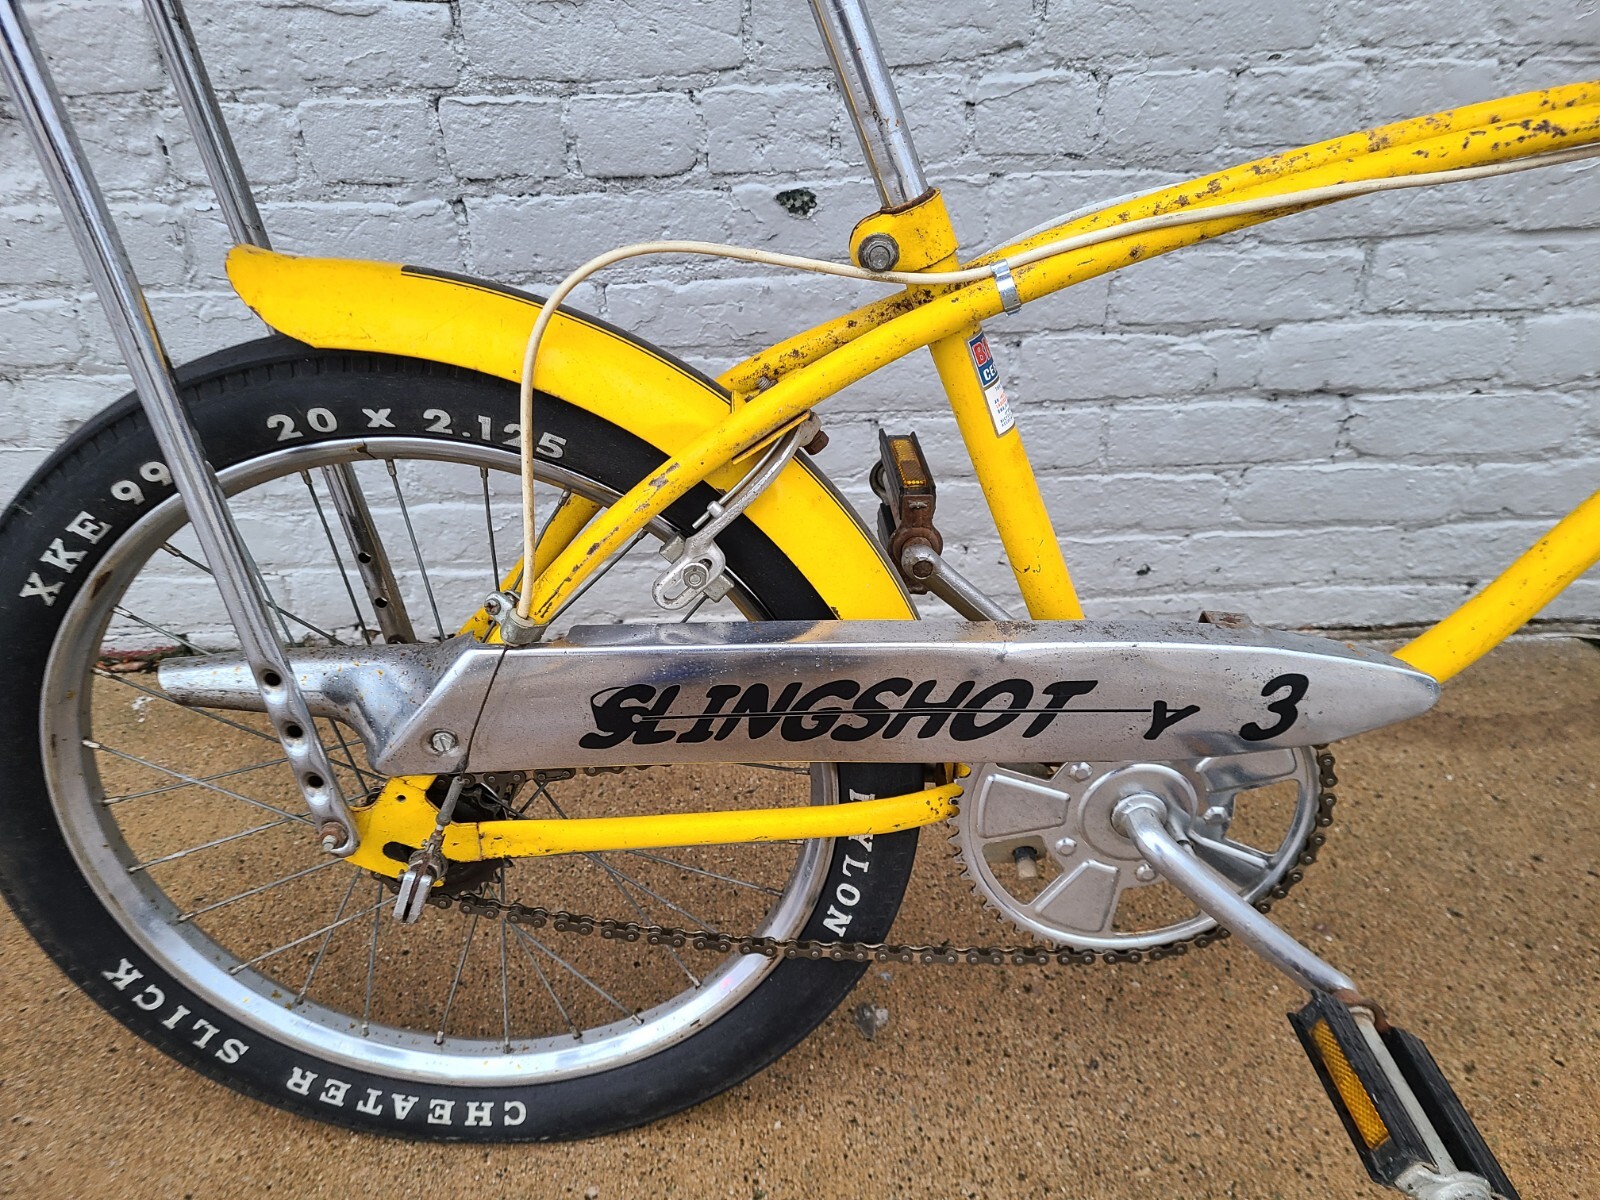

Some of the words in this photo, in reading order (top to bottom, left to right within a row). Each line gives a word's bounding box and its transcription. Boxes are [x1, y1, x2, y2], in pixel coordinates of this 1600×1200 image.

[266, 407, 338, 441] 20
[422, 408, 567, 458] 2.125
[19, 510, 110, 605] XKE
[110, 461, 174, 505] 99
[578, 677, 1099, 750] SLINGSHOT
[1239, 673, 1309, 741] 3
[103, 958, 250, 1064] SLICK
[286, 1066, 527, 1127] CHEATER
